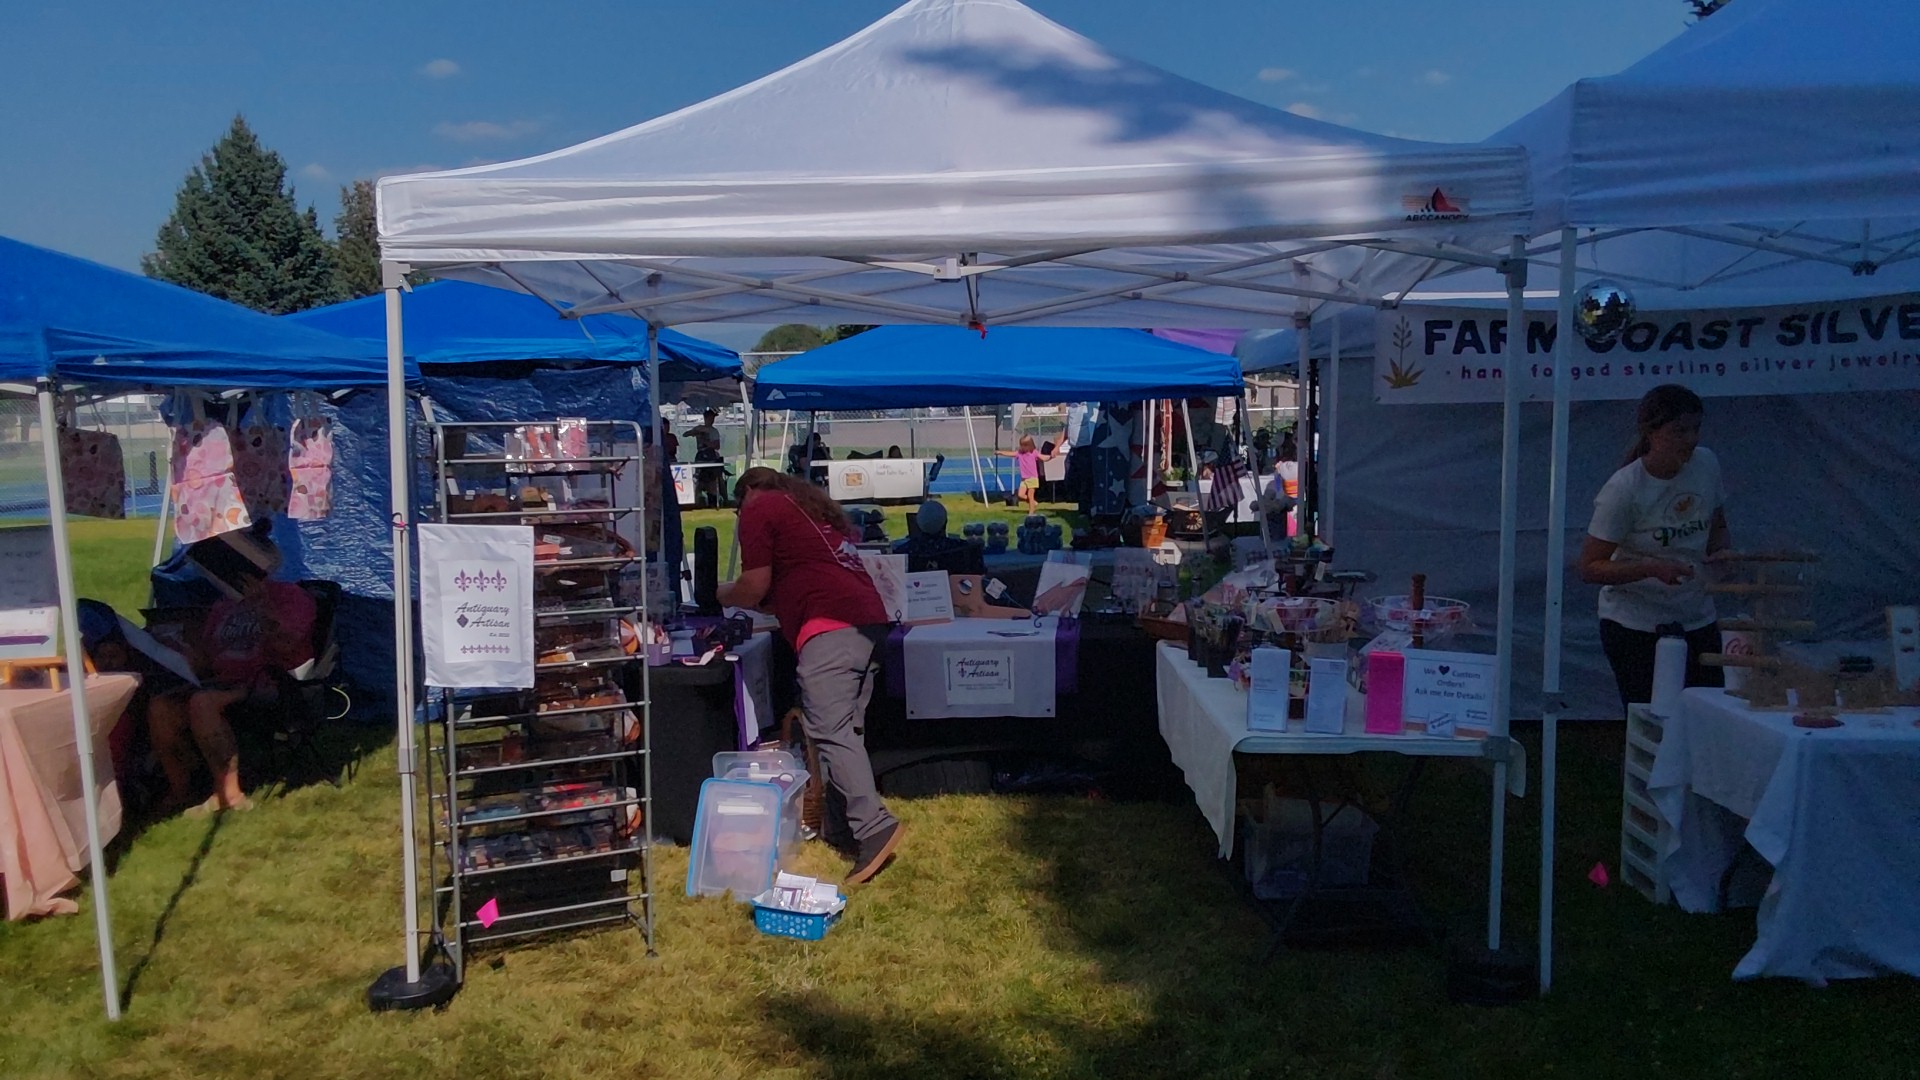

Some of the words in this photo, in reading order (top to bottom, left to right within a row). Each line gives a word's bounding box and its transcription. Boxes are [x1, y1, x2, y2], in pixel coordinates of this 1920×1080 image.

[1461, 365, 1503, 380] han
[1531, 362, 1610, 381] foged
[1623, 360, 1726, 377] sterling
[1740, 356, 1816, 373] silver
[455, 601, 510, 616] Antiquary
[469, 616, 510, 628] Artisan
[956, 657, 999, 668] Antiquary
[967, 667, 999, 679] Artisan
[1423, 667, 1436, 675] We
[1452, 670, 1481, 679] Custom
[1414, 687, 1428, 696] Ask
[1443, 690, 1455, 698] for
